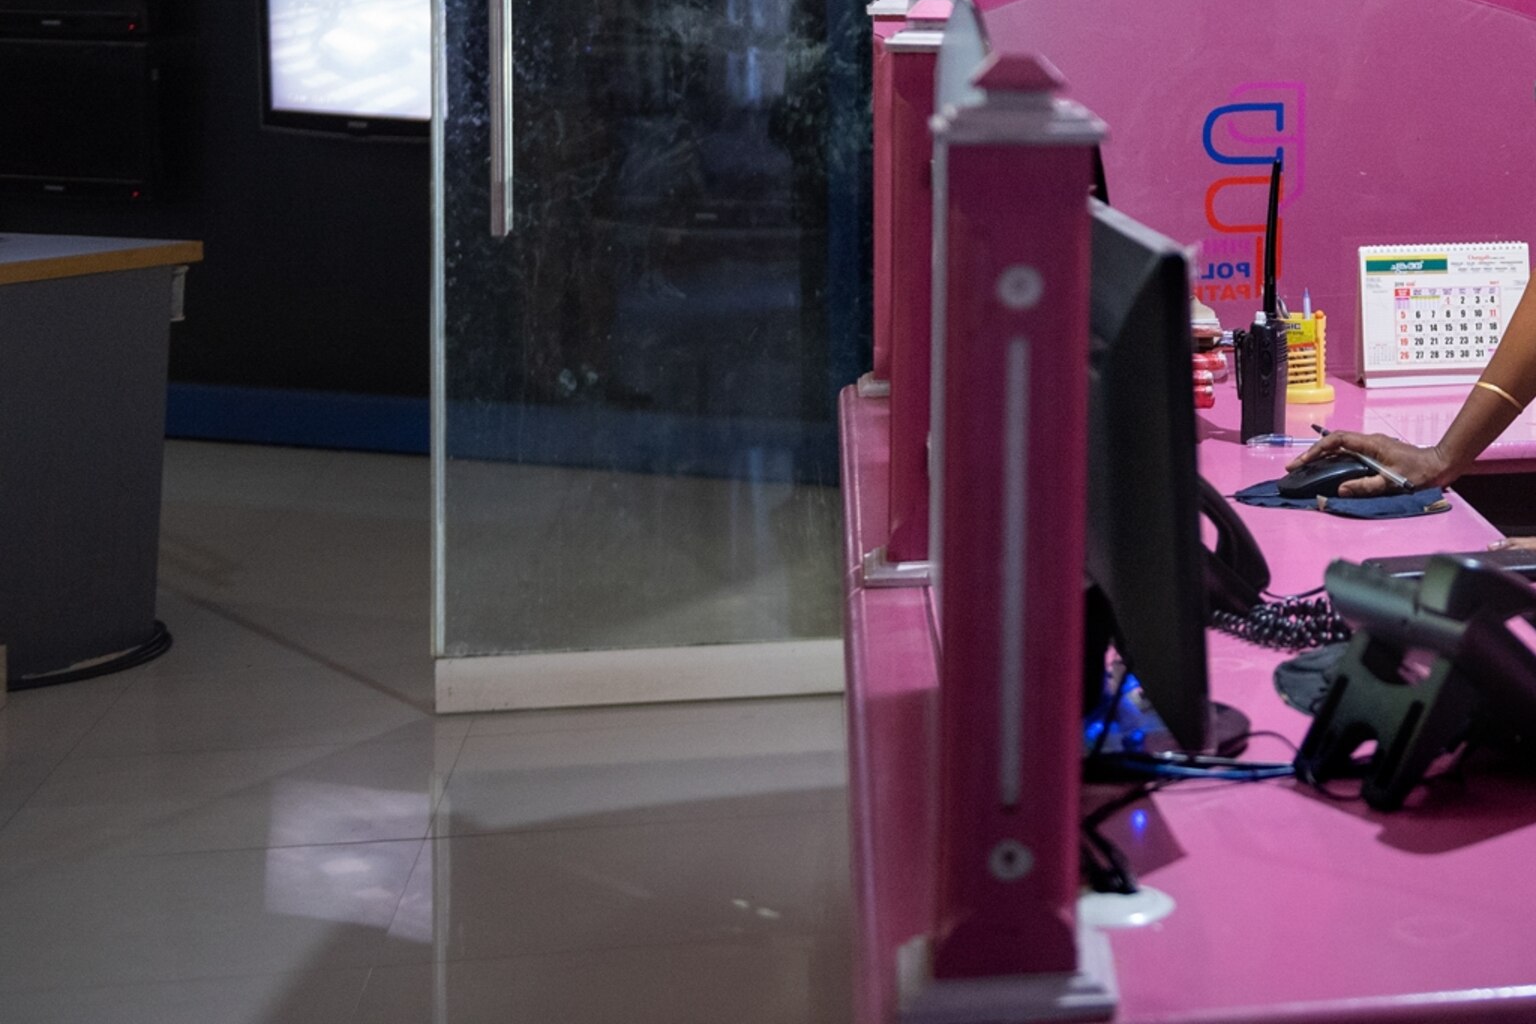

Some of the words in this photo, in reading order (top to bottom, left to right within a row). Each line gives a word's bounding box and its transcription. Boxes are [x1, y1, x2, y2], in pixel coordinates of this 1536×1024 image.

[1461, 296, 1465, 304] 2
[1475, 296, 1480, 304] 3
[1400, 311, 1406, 319] 5
[1415, 311, 1421, 319] 6
[1431, 310, 1435, 318] 7
[1446, 310, 1451, 318] 8
[1460, 309, 1466, 318] 9
[1474, 309, 1482, 317] 10
[1489, 309, 1496, 317] 11
[1400, 324, 1408, 333] 12
[1415, 324, 1423, 332] 13
[1445, 323, 1453, 331] 15
[1460, 323, 1468, 331] 16
[1475, 322, 1482, 330] 17
[1489, 322, 1497, 330] 18
[1400, 337, 1409, 346] 19
[1414, 337, 1424, 346] 20
[1430, 337, 1438, 345] 21
[1445, 336, 1454, 345] 22
[1460, 336, 1469, 344] 23
[1475, 336, 1484, 344] 24
[1489, 336, 1498, 344] 25
[1400, 351, 1409, 359] 26
[1416, 351, 1424, 359] 27
[1445, 350, 1454, 358] 29
[1460, 350, 1469, 358] 30
[1476, 349, 1484, 357] 31
